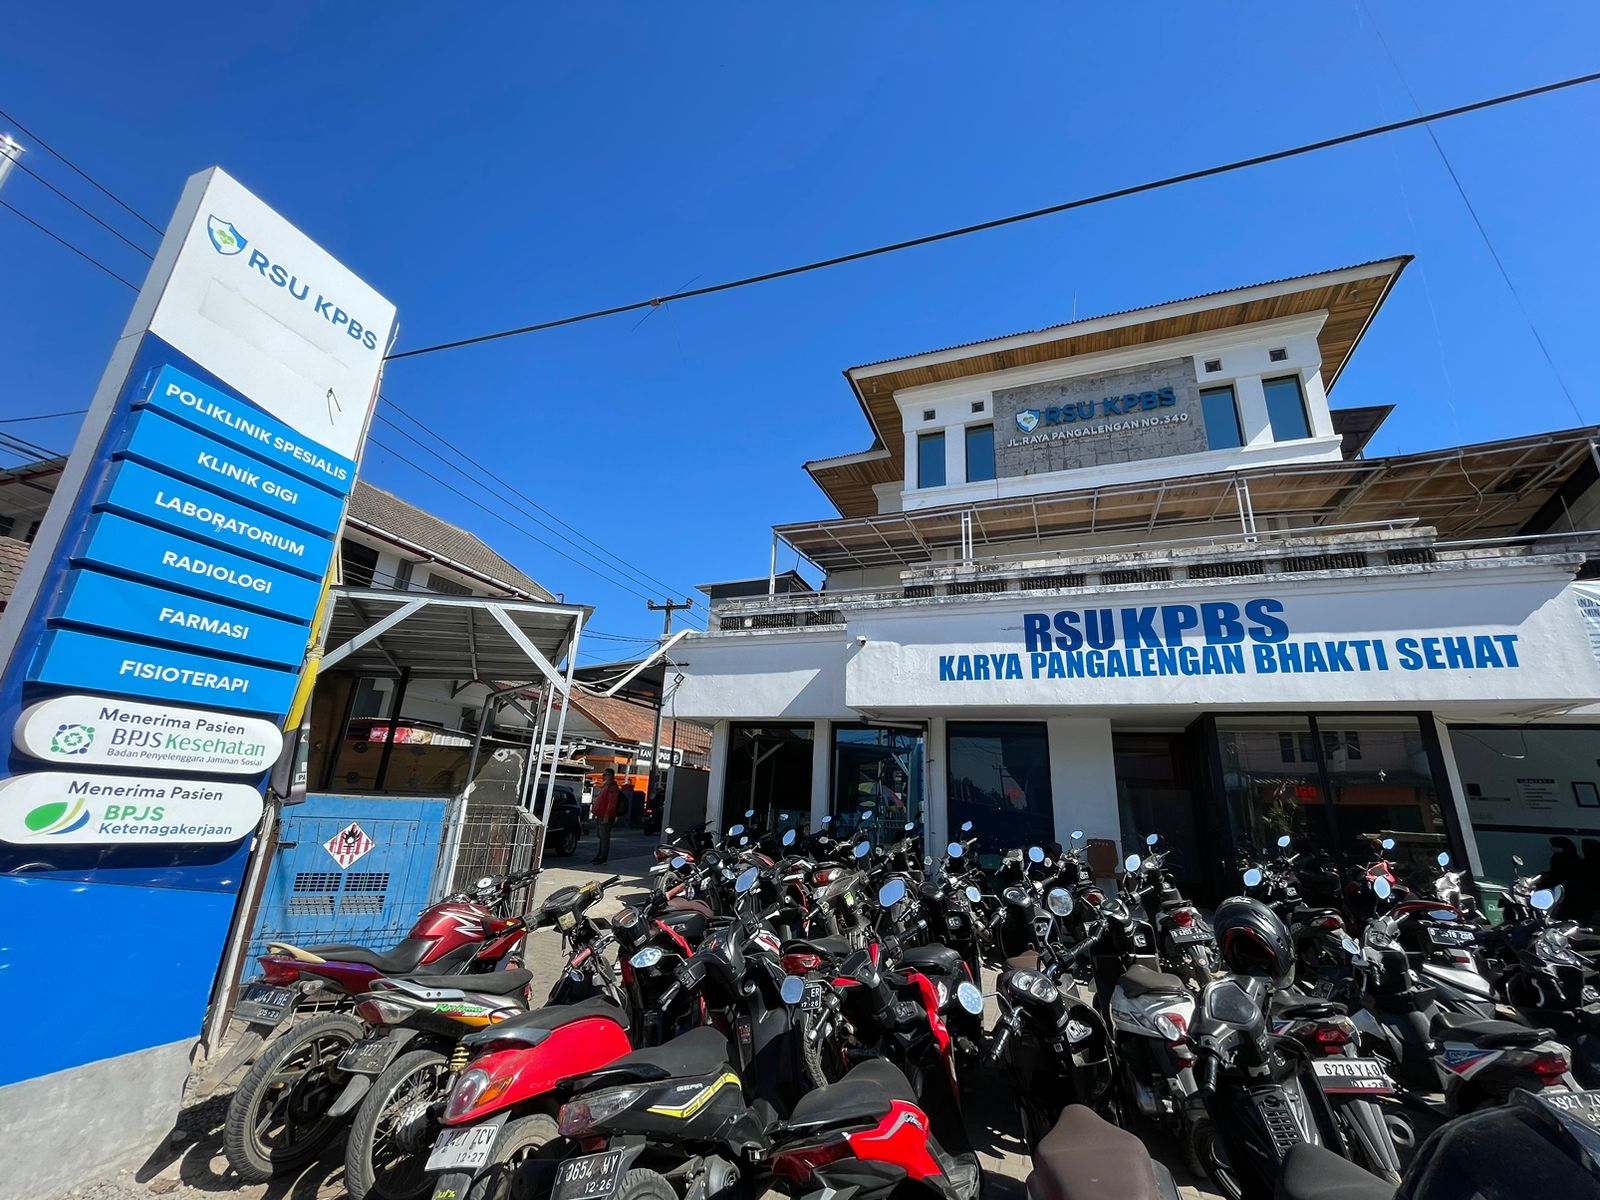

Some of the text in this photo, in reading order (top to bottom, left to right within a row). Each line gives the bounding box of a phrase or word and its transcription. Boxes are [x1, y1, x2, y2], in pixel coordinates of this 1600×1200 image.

[247, 248, 379, 352] RSU KPBS
[1045, 386, 1177, 427] RSU KPBS
[165, 383, 347, 482] POLIKLINIK SPESIALIS
[1052, 420, 1140, 441] PANGALENGAN
[1142, 412, 1189, 428] NO.340
[197, 451, 299, 505] KLINIK GIGI
[154, 491, 305, 557] LABORATORIUM
[162, 550, 273, 595] RADIOLOGI
[158, 607, 250, 641] FARMASI
[1023, 598, 1290, 653] RSU KPBS
[939, 633, 1520, 682] KARYA PANGALENGAN BHAKTI SEHAT
[119, 659, 250, 693] FISIOTERAPI
[99, 707, 245, 736] Menerima Pasien
[106, 748, 263, 767] Badan Penyelenggara Jaminan Sosial
[110, 728, 266, 757] BPJS Kesehatan
[67, 780, 224, 801] Menerima Pasien
[98, 822, 233, 837] Ketenagakerjaan
[103, 804, 166, 822] BPJS
[1324, 1063, 1354, 1077] 6278
[565, 1160, 596, 1182] 3654
